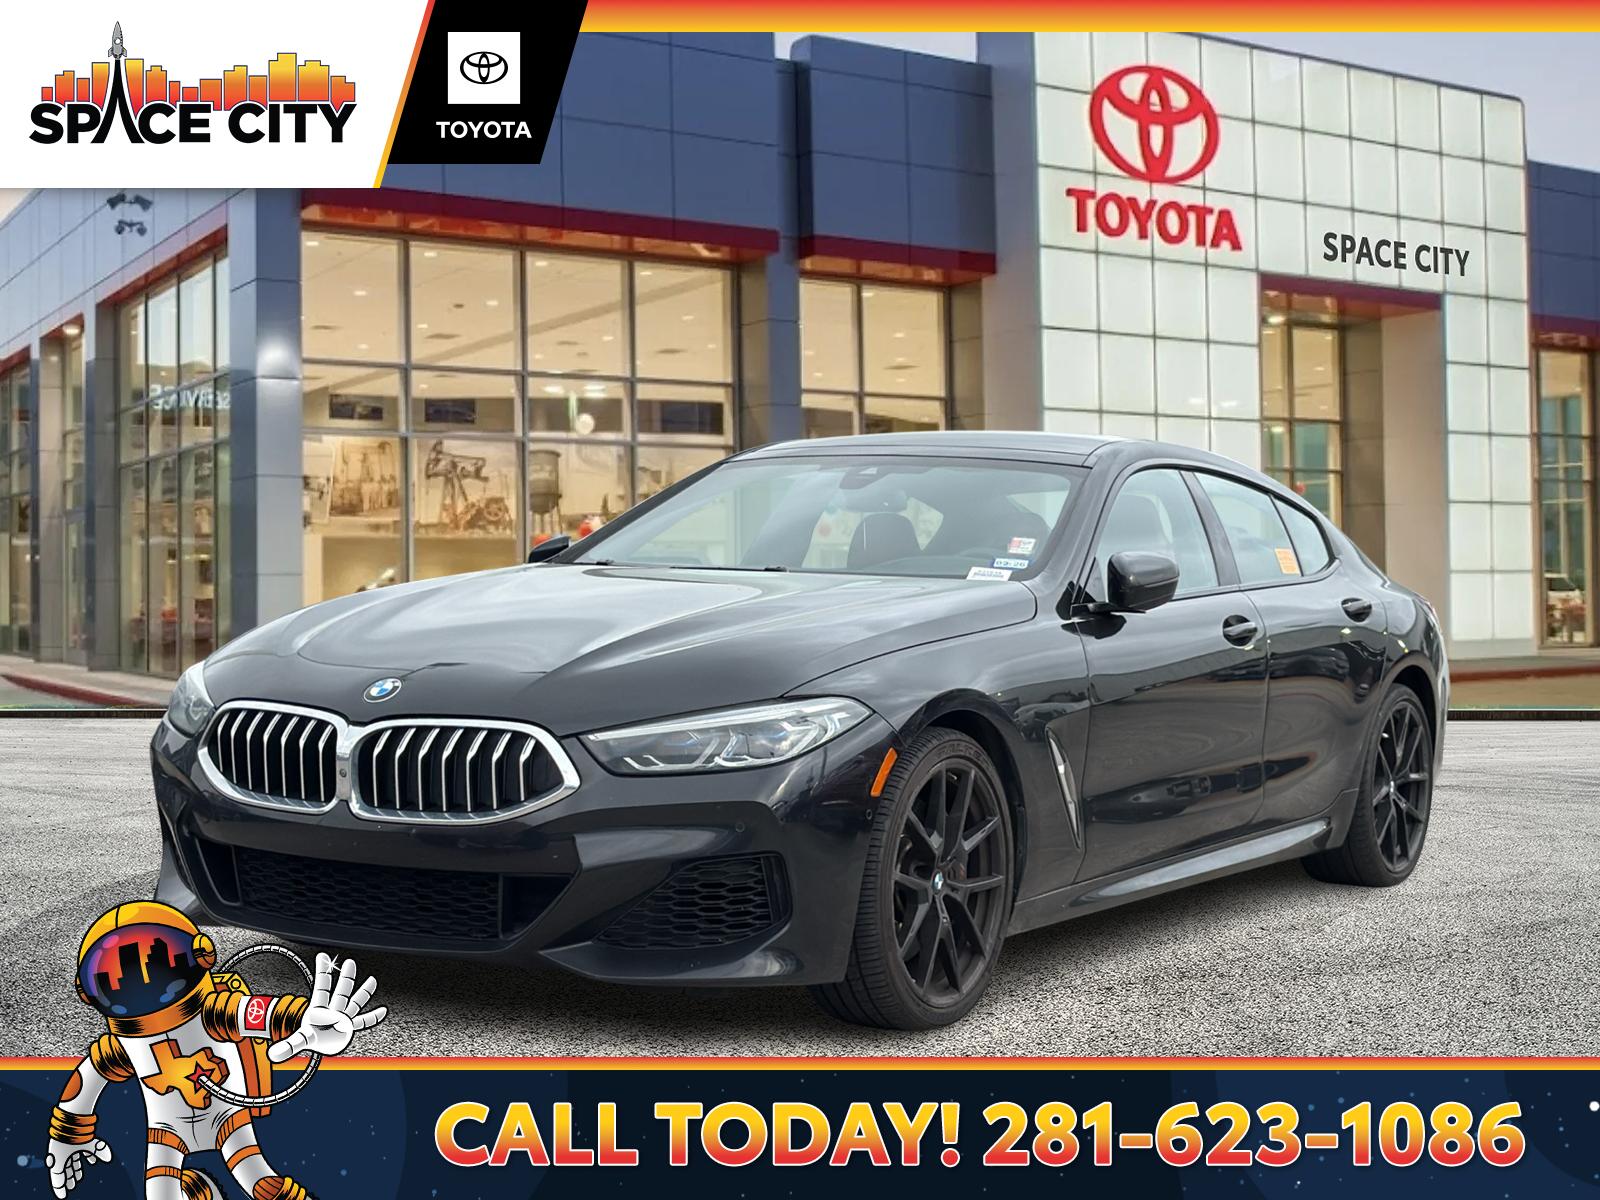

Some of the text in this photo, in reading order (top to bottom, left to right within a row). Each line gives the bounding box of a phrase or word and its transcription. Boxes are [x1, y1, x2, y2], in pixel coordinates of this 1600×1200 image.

[1067, 187, 1243, 251] TOYOTA
[1323, 232, 1471, 277] SPACE CITY
